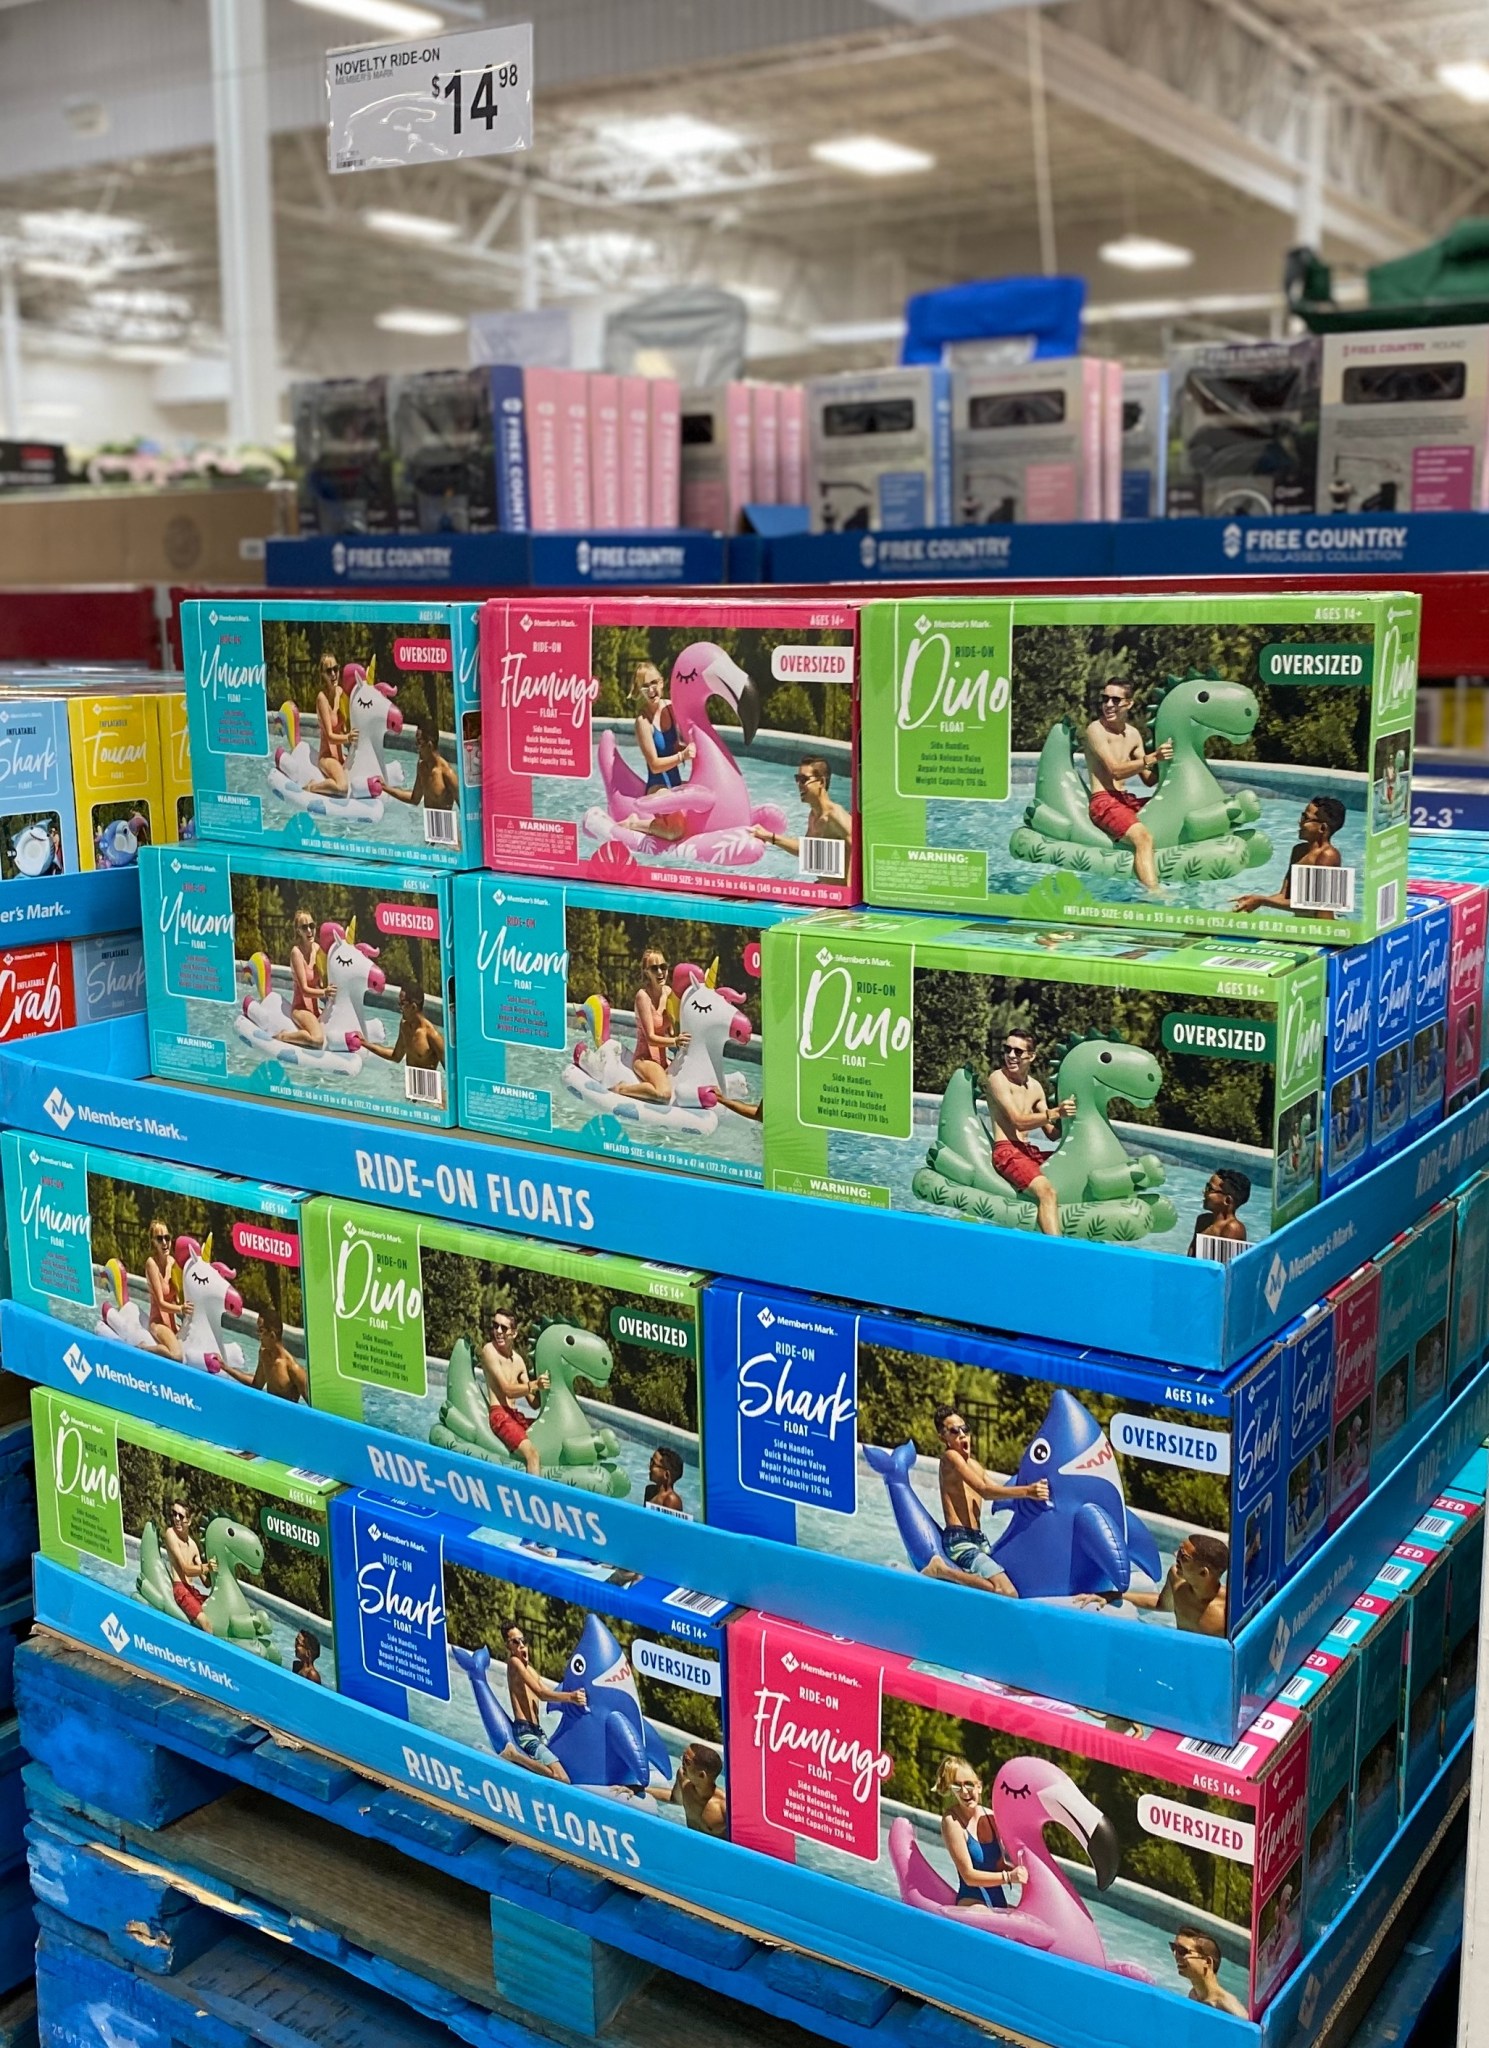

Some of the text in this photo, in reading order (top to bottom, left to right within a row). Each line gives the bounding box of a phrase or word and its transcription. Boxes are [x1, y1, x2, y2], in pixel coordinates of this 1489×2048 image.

[335, 48, 440, 75] NOVELTY RIDE-ON
[878, 536, 1009, 560] FREE COUNTRY
[1246, 527, 1408, 549] FREE COUNTRY
[348, 547, 451, 568] FREE COUNTRY
[592, 547, 685, 568] FREE COUNTRY
[1246, 550, 1403, 563] SUNGLASSES COLLECTION
[810, 615, 844, 625] AGES 14+
[1314, 607, 1363, 621] AGES 14+
[400, 647, 447, 664] OVERSIZED
[533, 642, 562, 653] RIDE-ON
[955, 646, 994, 658] RIDE-ON
[201, 644, 266, 701] Unicorn
[780, 655, 845, 673] OVERSIZED
[1270, 655, 1363, 676] OVERSIZED
[500, 652, 599, 728] Flamingo
[898, 634, 1009, 730] Dino
[540, 708, 558, 718] FLOAT
[6, 726, 36, 736] INFLATABLE
[940, 722, 965, 733] FLOAT
[83, 730, 146, 776] Toucan
[217, 795, 251, 806] WARNING:
[519, 820, 564, 834] WARNING:
[908, 849, 969, 864] WARNING:
[0, 902, 64, 922] er's Mark
[160, 892, 235, 945] Unicorn
[382, 910, 434, 931] OVERSIZED
[102, 948, 129, 959] INFLATABLE
[191, 940, 206, 949] FLOAT
[1204, 945, 1297, 959] OVERSIZED
[477, 926, 569, 985] Unicorn
[835, 954, 891, 967] Member's Mark
[17, 978, 45, 990] INFLATABLE
[514, 979, 532, 990] FLOAT
[857, 982, 895, 996] RIDE-ON
[1217, 980, 1265, 997] AGES 14+
[0, 962, 61, 1038] Crab
[800, 967, 911, 1059] Dino
[176, 1036, 215, 1050] WARNING:
[1173, 1023, 1266, 1052] OVERSIZED
[842, 1055, 866, 1067] FLOAT
[492, 1085, 537, 1101] WARNING:
[78, 1105, 181, 1141] Member's Mark
[355, 1149, 595, 1230] RIDE-ON FLOATS
[810, 1180, 871, 1199] WARNING:
[20, 1184, 91, 1242] Unicorn
[261, 1201, 288, 1215] AGES 14+
[239, 1230, 292, 1258] OVERSIZED
[358, 1228, 401, 1243] Member's Mark
[377, 1253, 408, 1270] RIDE-ON
[1288, 1221, 1354, 1282] Member's Mark
[335, 1240, 422, 1324] Dino
[649, 1282, 685, 1300] AGES 14+
[369, 1317, 389, 1331] FLOAT
[618, 1316, 688, 1348] OVERSIZED
[777, 1316, 834, 1335] Member's Mark
[776, 1341, 815, 1362] RIDE-ON
[95, 1363, 195, 1411] Member's Mark
[739, 1353, 855, 1441] Shark
[1165, 1386, 1214, 1407] AGES 14+
[784, 1420, 808, 1437] FLOAT
[774, 1438, 814, 1457] Side Handles
[1122, 1424, 1218, 1463] OVERSIZED
[55, 1425, 120, 1504] Dino
[764, 1448, 826, 1472] Quick Release Valve
[761, 1459, 830, 1485] Repair Patch Included
[759, 1470, 832, 1498] Weight Capacity 176 lbs
[80, 1494, 96, 1508] FLOAT
[367, 1444, 608, 1547] RIDE-ON FLOATS
[267, 1515, 320, 1548] OVERSIZED
[382, 1531, 425, 1552] Member's Mark
[383, 1552, 412, 1573] RIDE-ON
[358, 1562, 445, 1640] Shark
[393, 1619, 412, 1635] FLOAT
[671, 1619, 708, 1639] AGES 14+
[134, 1634, 233, 1690] Member's Mark
[640, 1650, 711, 1687] OVERSIZED
[801, 1661, 858, 1687] Member's Mark
[799, 1686, 839, 1710] RIDE-ON
[754, 1686, 891, 1803] Flamingo
[808, 1764, 832, 1782] FLOAT
[798, 1780, 837, 1802] Side Handles
[1192, 1773, 1242, 1797] AGES 14+
[402, 1745, 640, 1869] RIDE-ON FLOATS
[788, 1788, 850, 1818] Quick Release Valve
[785, 1799, 853, 1831] Repair Patch Included
[783, 1809, 855, 1843] Weight Capacity 176 lbs
[1149, 1805, 1244, 1852] OVERSIZED
